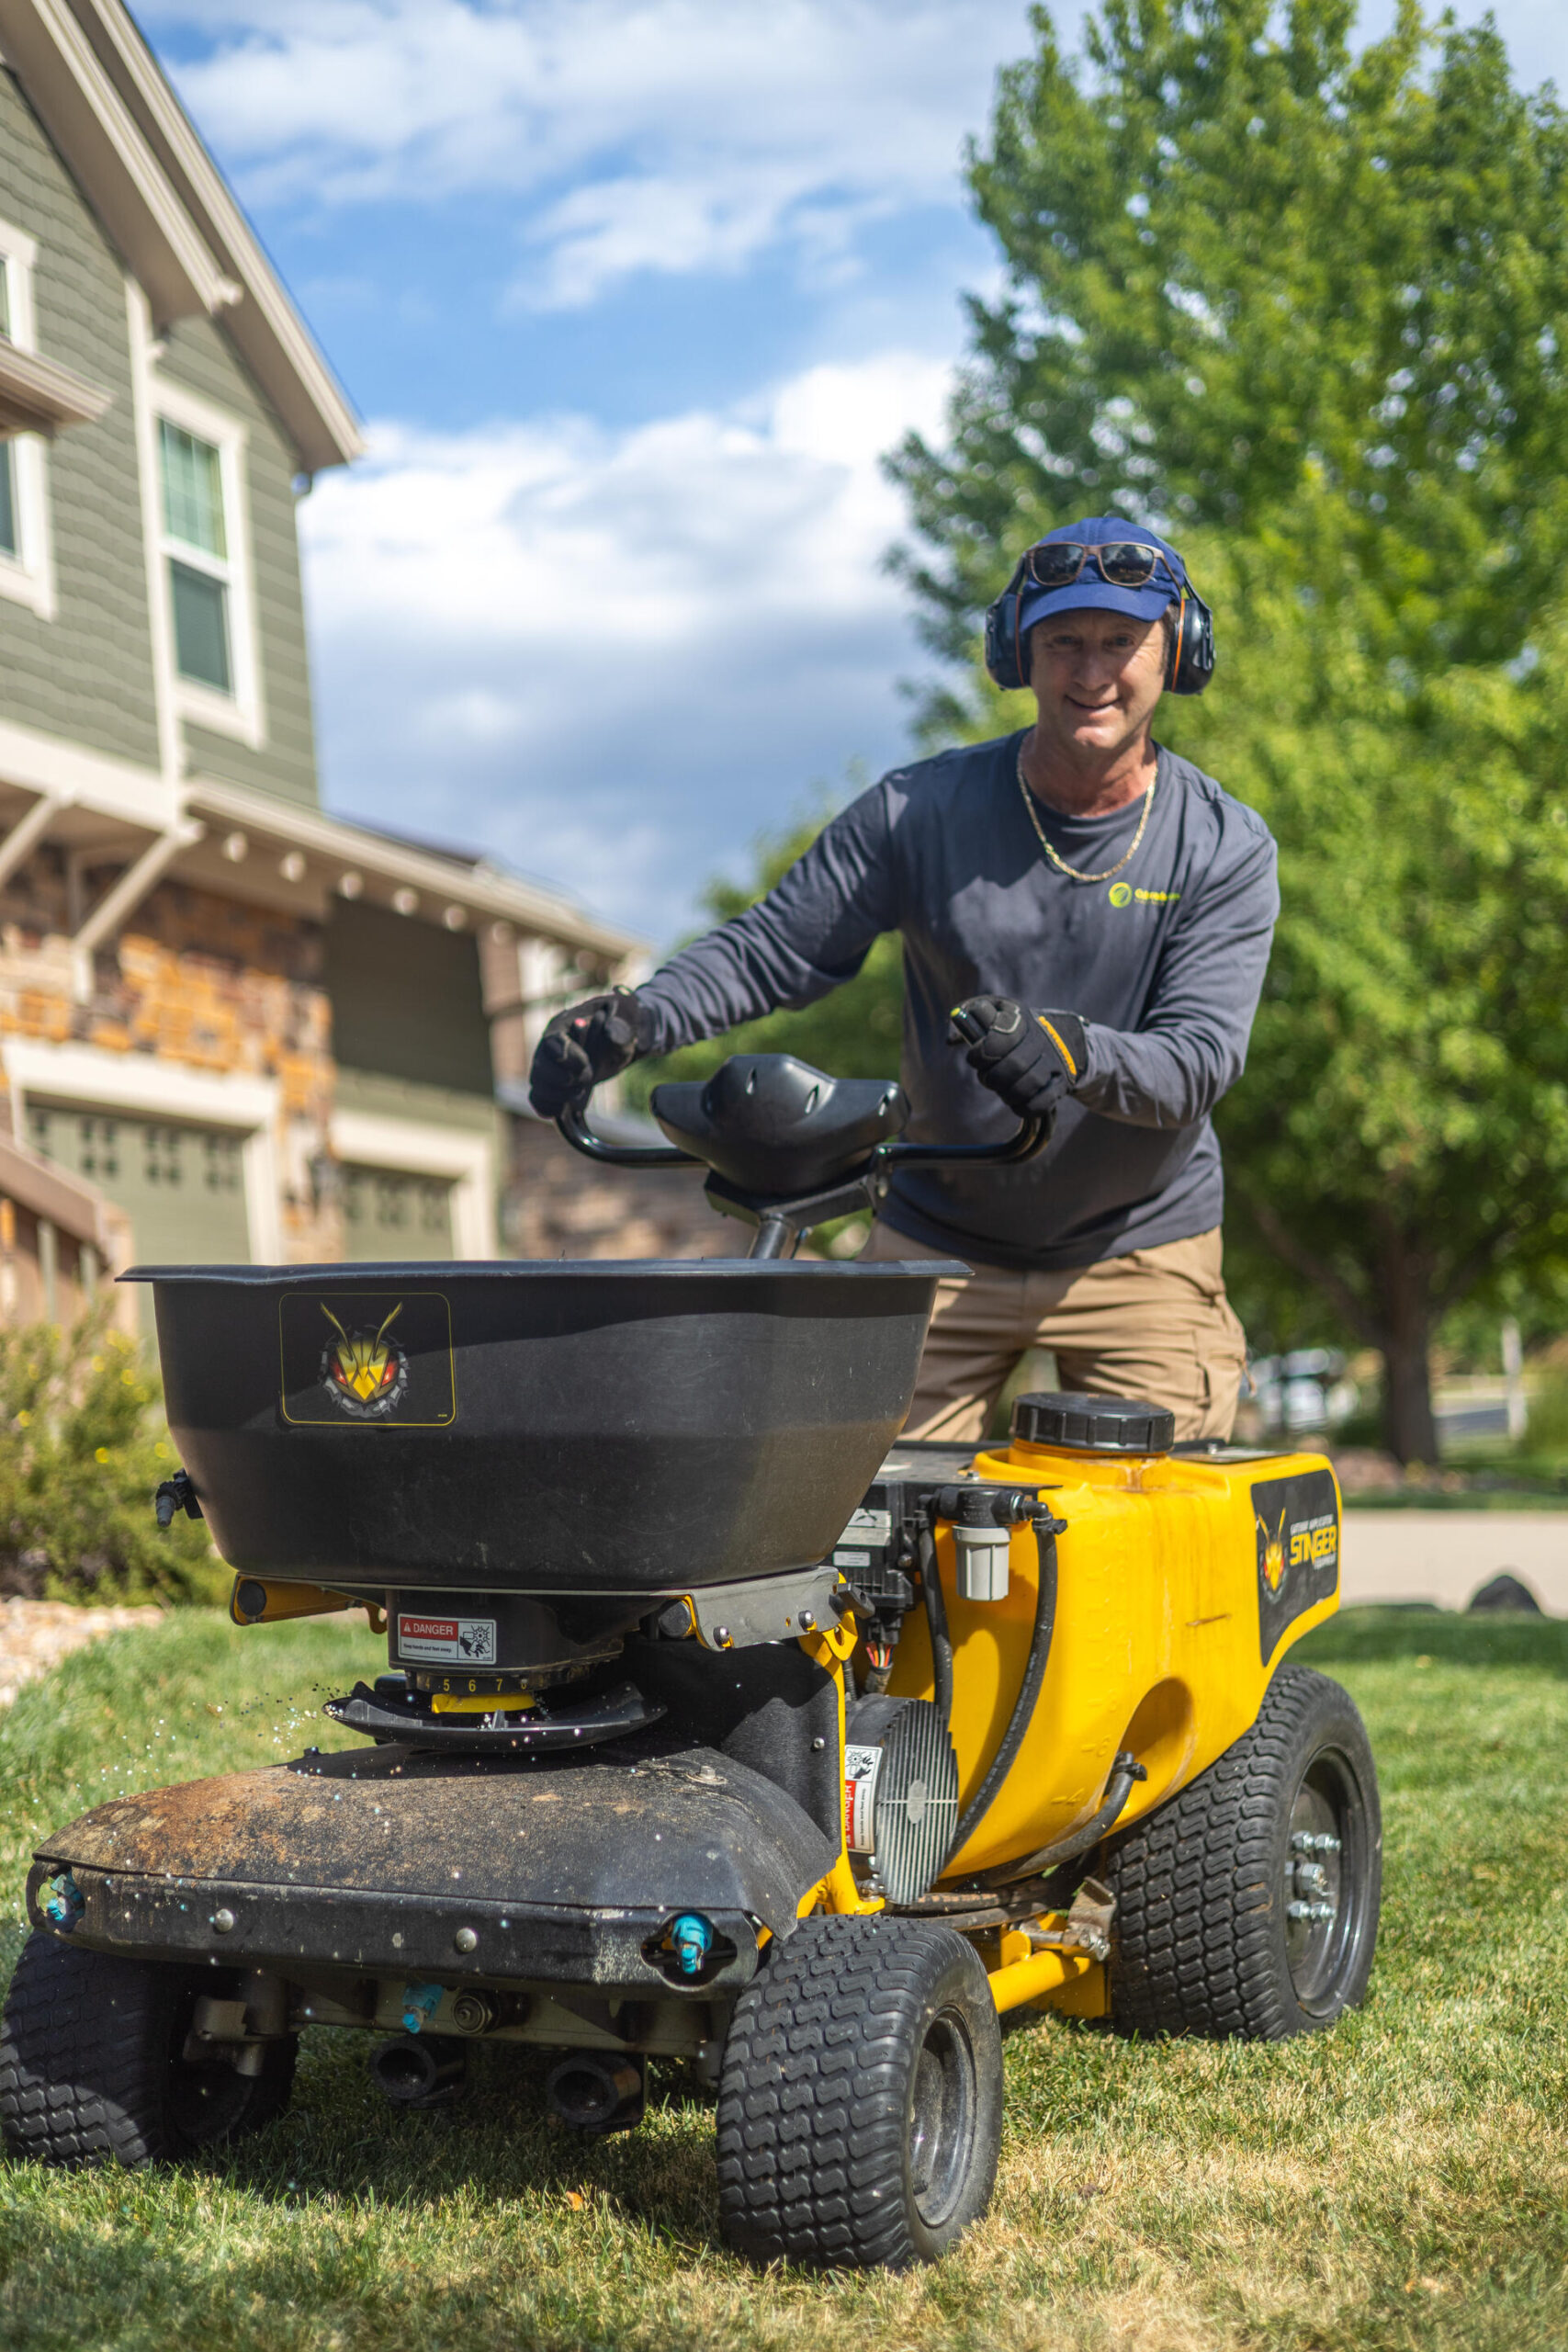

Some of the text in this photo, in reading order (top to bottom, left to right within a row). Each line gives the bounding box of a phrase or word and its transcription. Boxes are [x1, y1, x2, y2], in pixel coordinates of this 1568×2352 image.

[1290, 1525, 1337, 1566] STINGER
[413, 1623, 454, 1635] DANGER
[443, 1679, 450, 1691] 5
[468, 1679, 477, 1691] 6
[496, 1679, 503, 1691] 7
